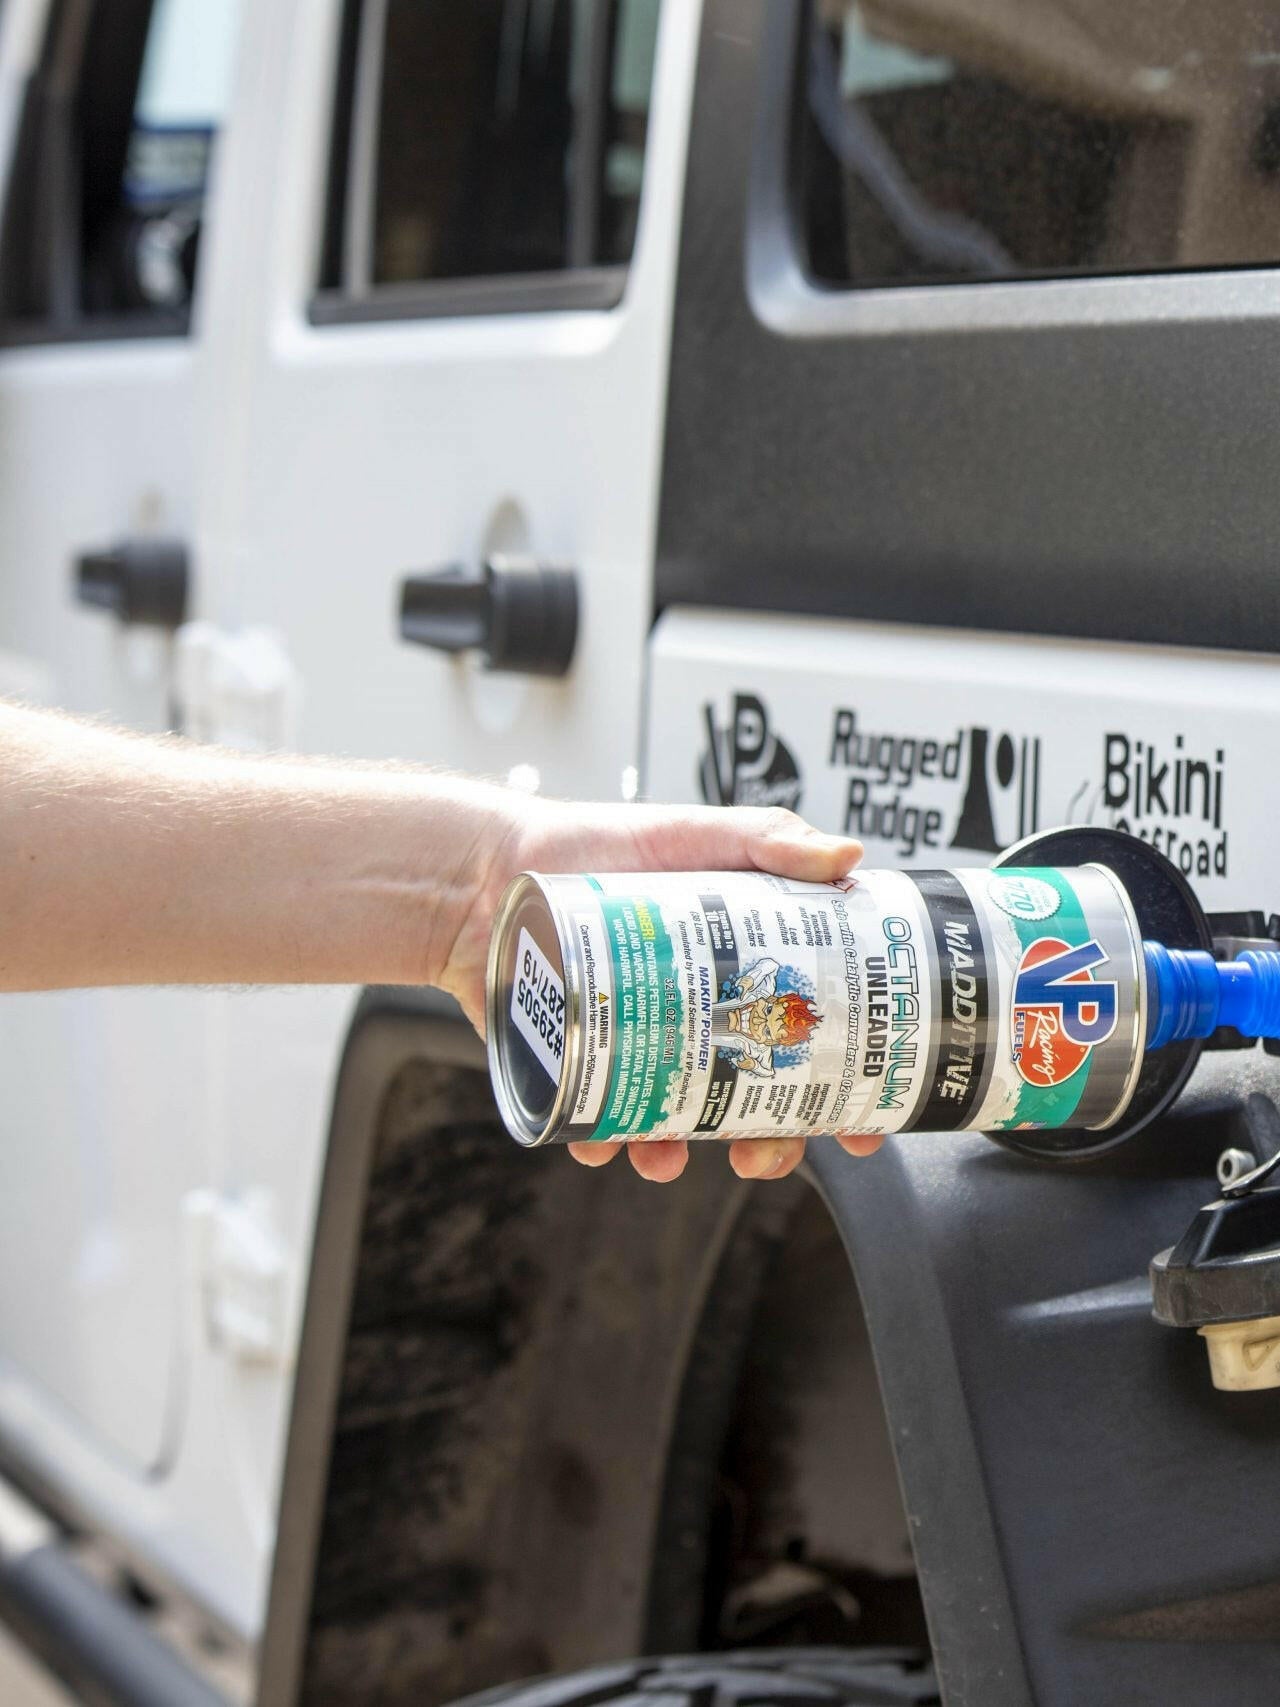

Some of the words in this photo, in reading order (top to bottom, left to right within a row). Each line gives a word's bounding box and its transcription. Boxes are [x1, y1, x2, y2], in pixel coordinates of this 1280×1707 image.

[830, 708, 964, 789] Rugged
[1102, 733, 1225, 829] Bikini
[844, 776, 943, 857] Ridge
[1115, 817, 1228, 878] road
[622, 906, 637, 931] LIQUID
[632, 897, 656, 941] ANGER!
[705, 911, 719, 922] 10
[831, 899, 848, 920] Safe
[580, 924, 591, 949] Cancer
[613, 918, 627, 945] VAPOR
[629, 931, 641, 949] AND
[678, 920, 693, 960] Formulated
[750, 910, 762, 933] Cleans
[758, 933, 767, 948] fuel
[775, 911, 790, 945] substitute
[788, 928, 799, 945] Lead
[802, 924, 815, 946] pinging
[810, 914, 824, 946] knocking
[818, 911, 833, 946] Eliminates
[839, 922, 855, 946] with
[584, 948, 592, 962] and
[632, 951, 645, 984] VAPOR.
[644, 942, 659, 986] CONTAINS
[685, 962, 694, 970] by
[523, 949, 566, 1024] 287/19
[585, 962, 597, 1009] Reproductive
[664, 979, 675, 990] 32
[687, 973, 695, 986] the
[845, 948, 861, 1001] Catalytic
[623, 995, 633, 1019] CALL
[665, 993, 675, 1006] FL
[688, 988, 696, 1005] Mad
[1013, 938, 1119, 1047] VP
[517, 977, 564, 1059] #29505
[588, 1010, 599, 1031] Harm
[636, 986, 646, 1033] HARMFUL
[649, 988, 660, 1045] PETROLEUM
[666, 1009, 676, 1023] OZ
[862, 956, 889, 1078] UNLEADED
[876, 916, 920, 1111] OCTANIUM
[938, 920, 979, 1100] MADDITIVE
[598, 1005, 609, 1049] WARNING
[635, 1035, 646, 1048] OR
[663, 1025, 675, 1047] (946
[845, 1003, 861, 1067] Converters
[1010, 1011, 1024, 1063] FUELS
[621, 1021, 634, 1069] PHYSICIAN
[661, 1048, 674, 1065] ML)
[686, 1051, 693, 1060] at
[697, 1020, 712, 1071] POWER!
[1026, 1010, 1058, 1085] Racing
[633, 1049, 645, 1075] FATAL
[685, 1061, 693, 1070] VP
[842, 1069, 855, 1079] &
[679, 1072, 692, 1095] Racing
[749, 1085, 765, 1113] Increases
